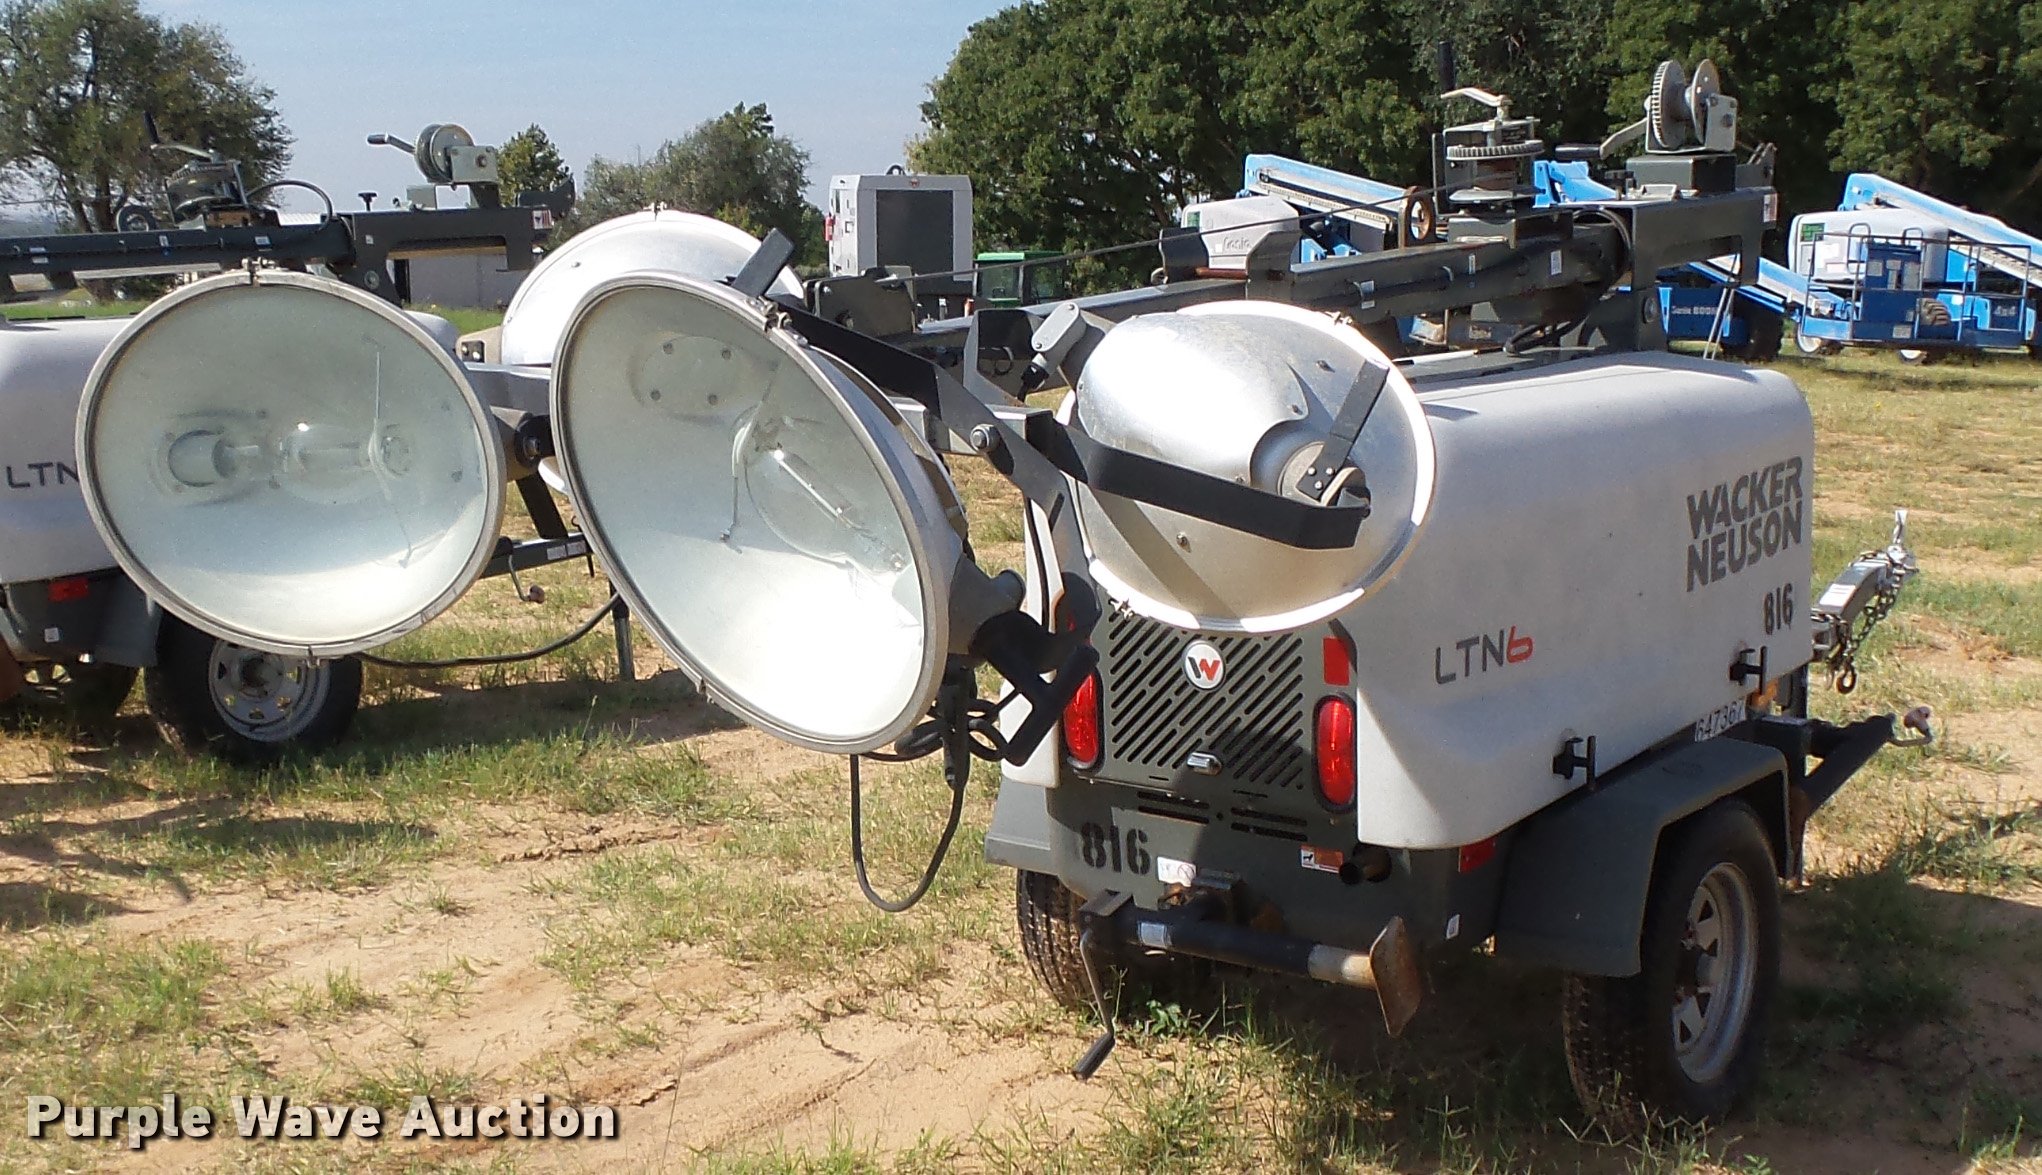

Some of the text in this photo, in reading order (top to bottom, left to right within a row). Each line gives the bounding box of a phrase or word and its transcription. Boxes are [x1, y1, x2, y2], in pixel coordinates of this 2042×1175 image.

[1687, 456, 1803, 539] WACKER
[1686, 500, 1803, 592] NEUSON
[1763, 582, 1793, 635] 816
[1435, 625, 1533, 684] LTN6
[1080, 821, 1151, 875] 816
